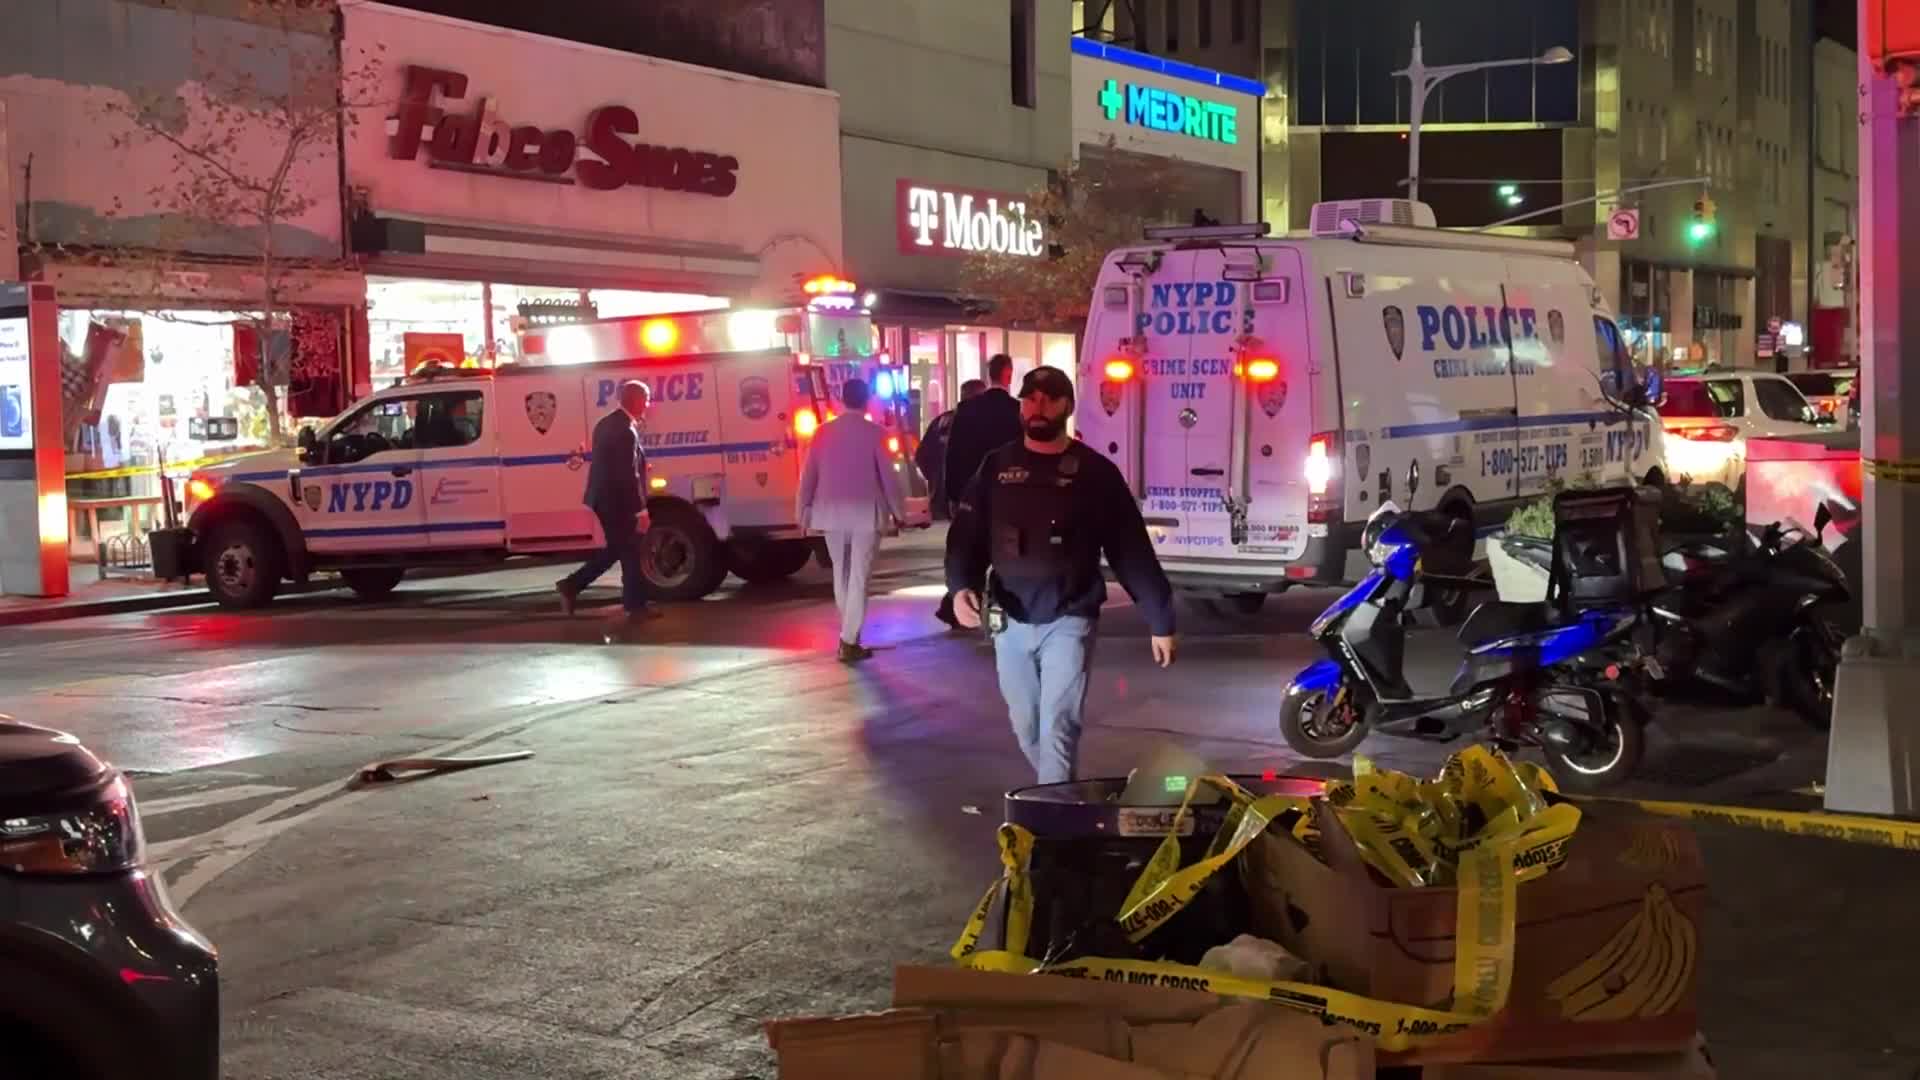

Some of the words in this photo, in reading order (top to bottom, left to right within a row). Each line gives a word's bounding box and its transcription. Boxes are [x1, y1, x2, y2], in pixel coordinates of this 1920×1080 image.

[1152, 281, 1235, 307] NYPD
[1416, 304, 1538, 351] POLICE
[1192, 358, 1230, 376] SCEN
[1170, 382, 1206, 399] UNIT
[328, 480, 412, 512] NYPD
